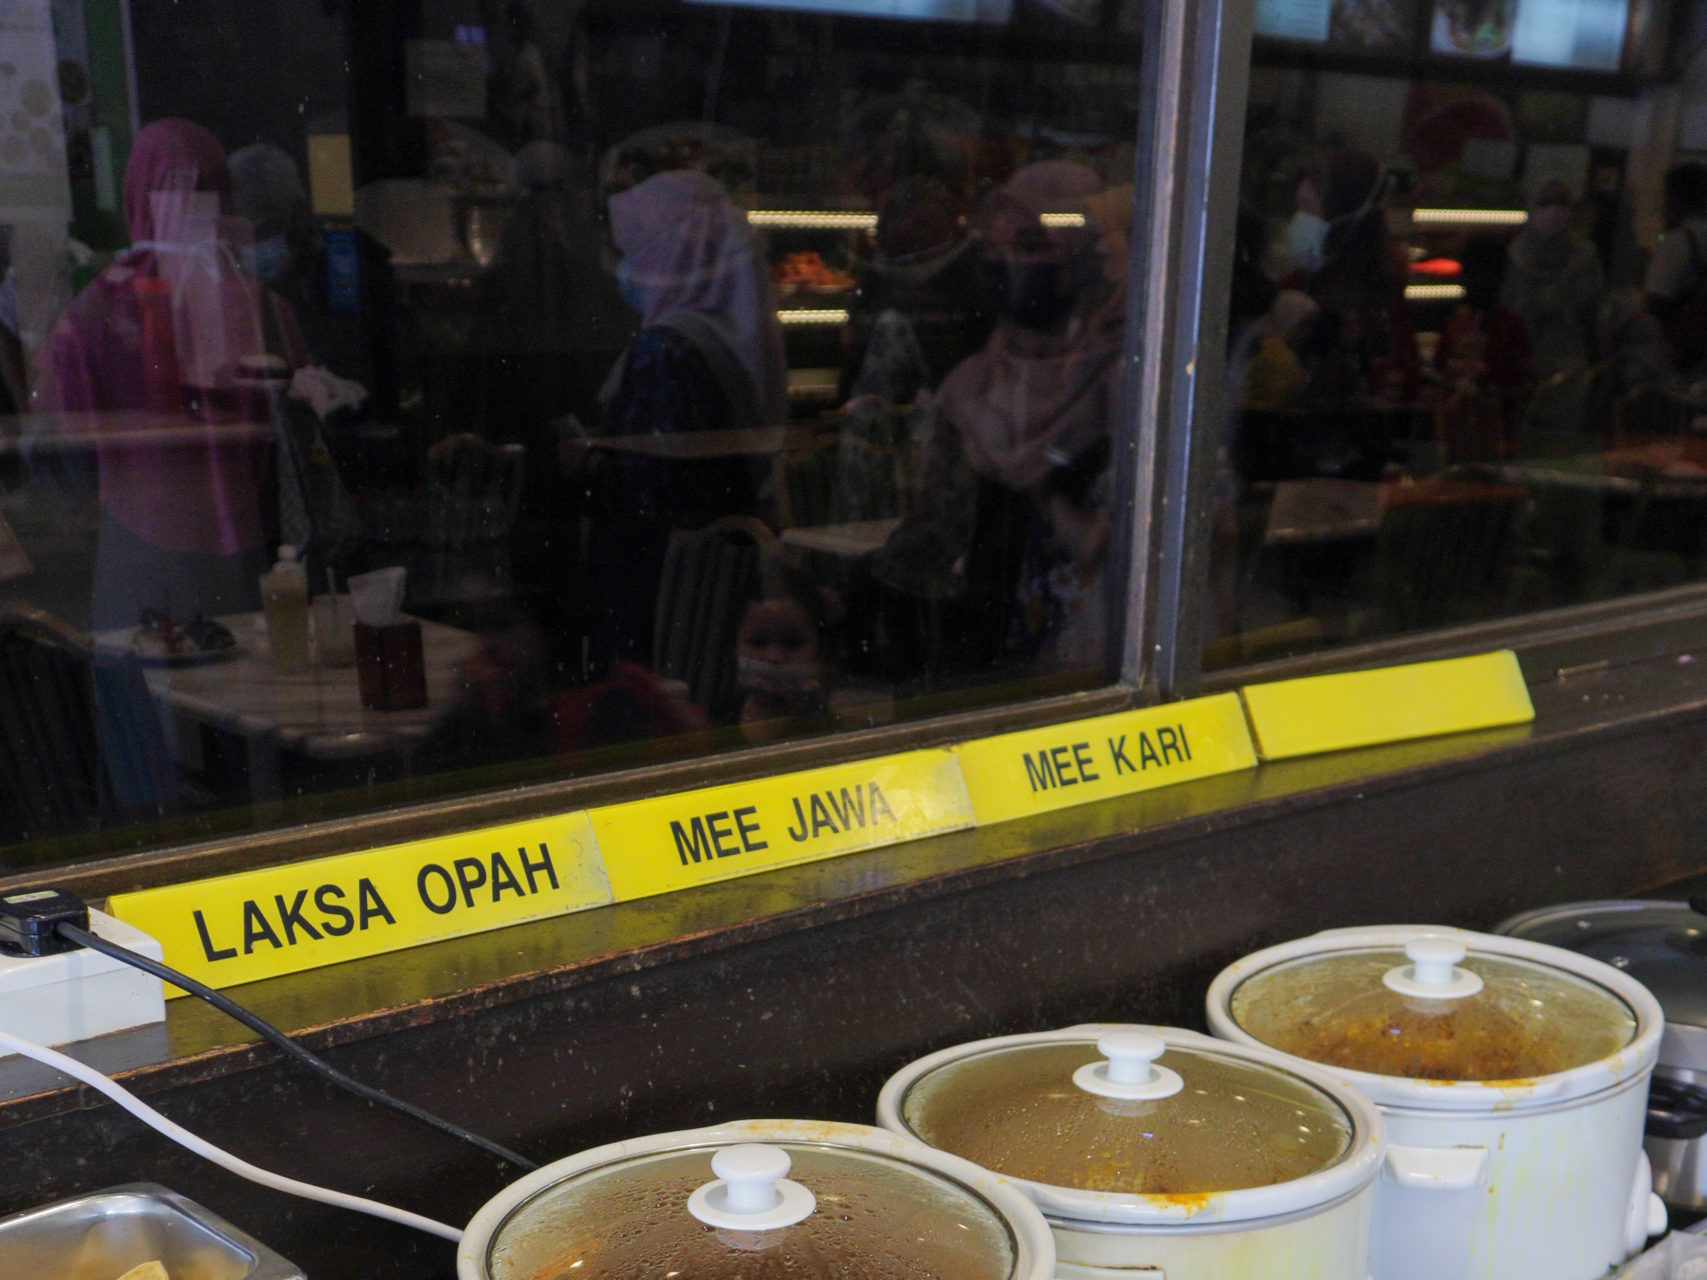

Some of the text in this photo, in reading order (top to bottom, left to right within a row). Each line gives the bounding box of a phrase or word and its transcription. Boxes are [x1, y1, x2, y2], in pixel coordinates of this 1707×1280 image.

[1022, 724, 1193, 793] MEE KARI
[670, 781, 898, 866] MEE JAWA
[192, 842, 561, 963] LAKSA OPAH
